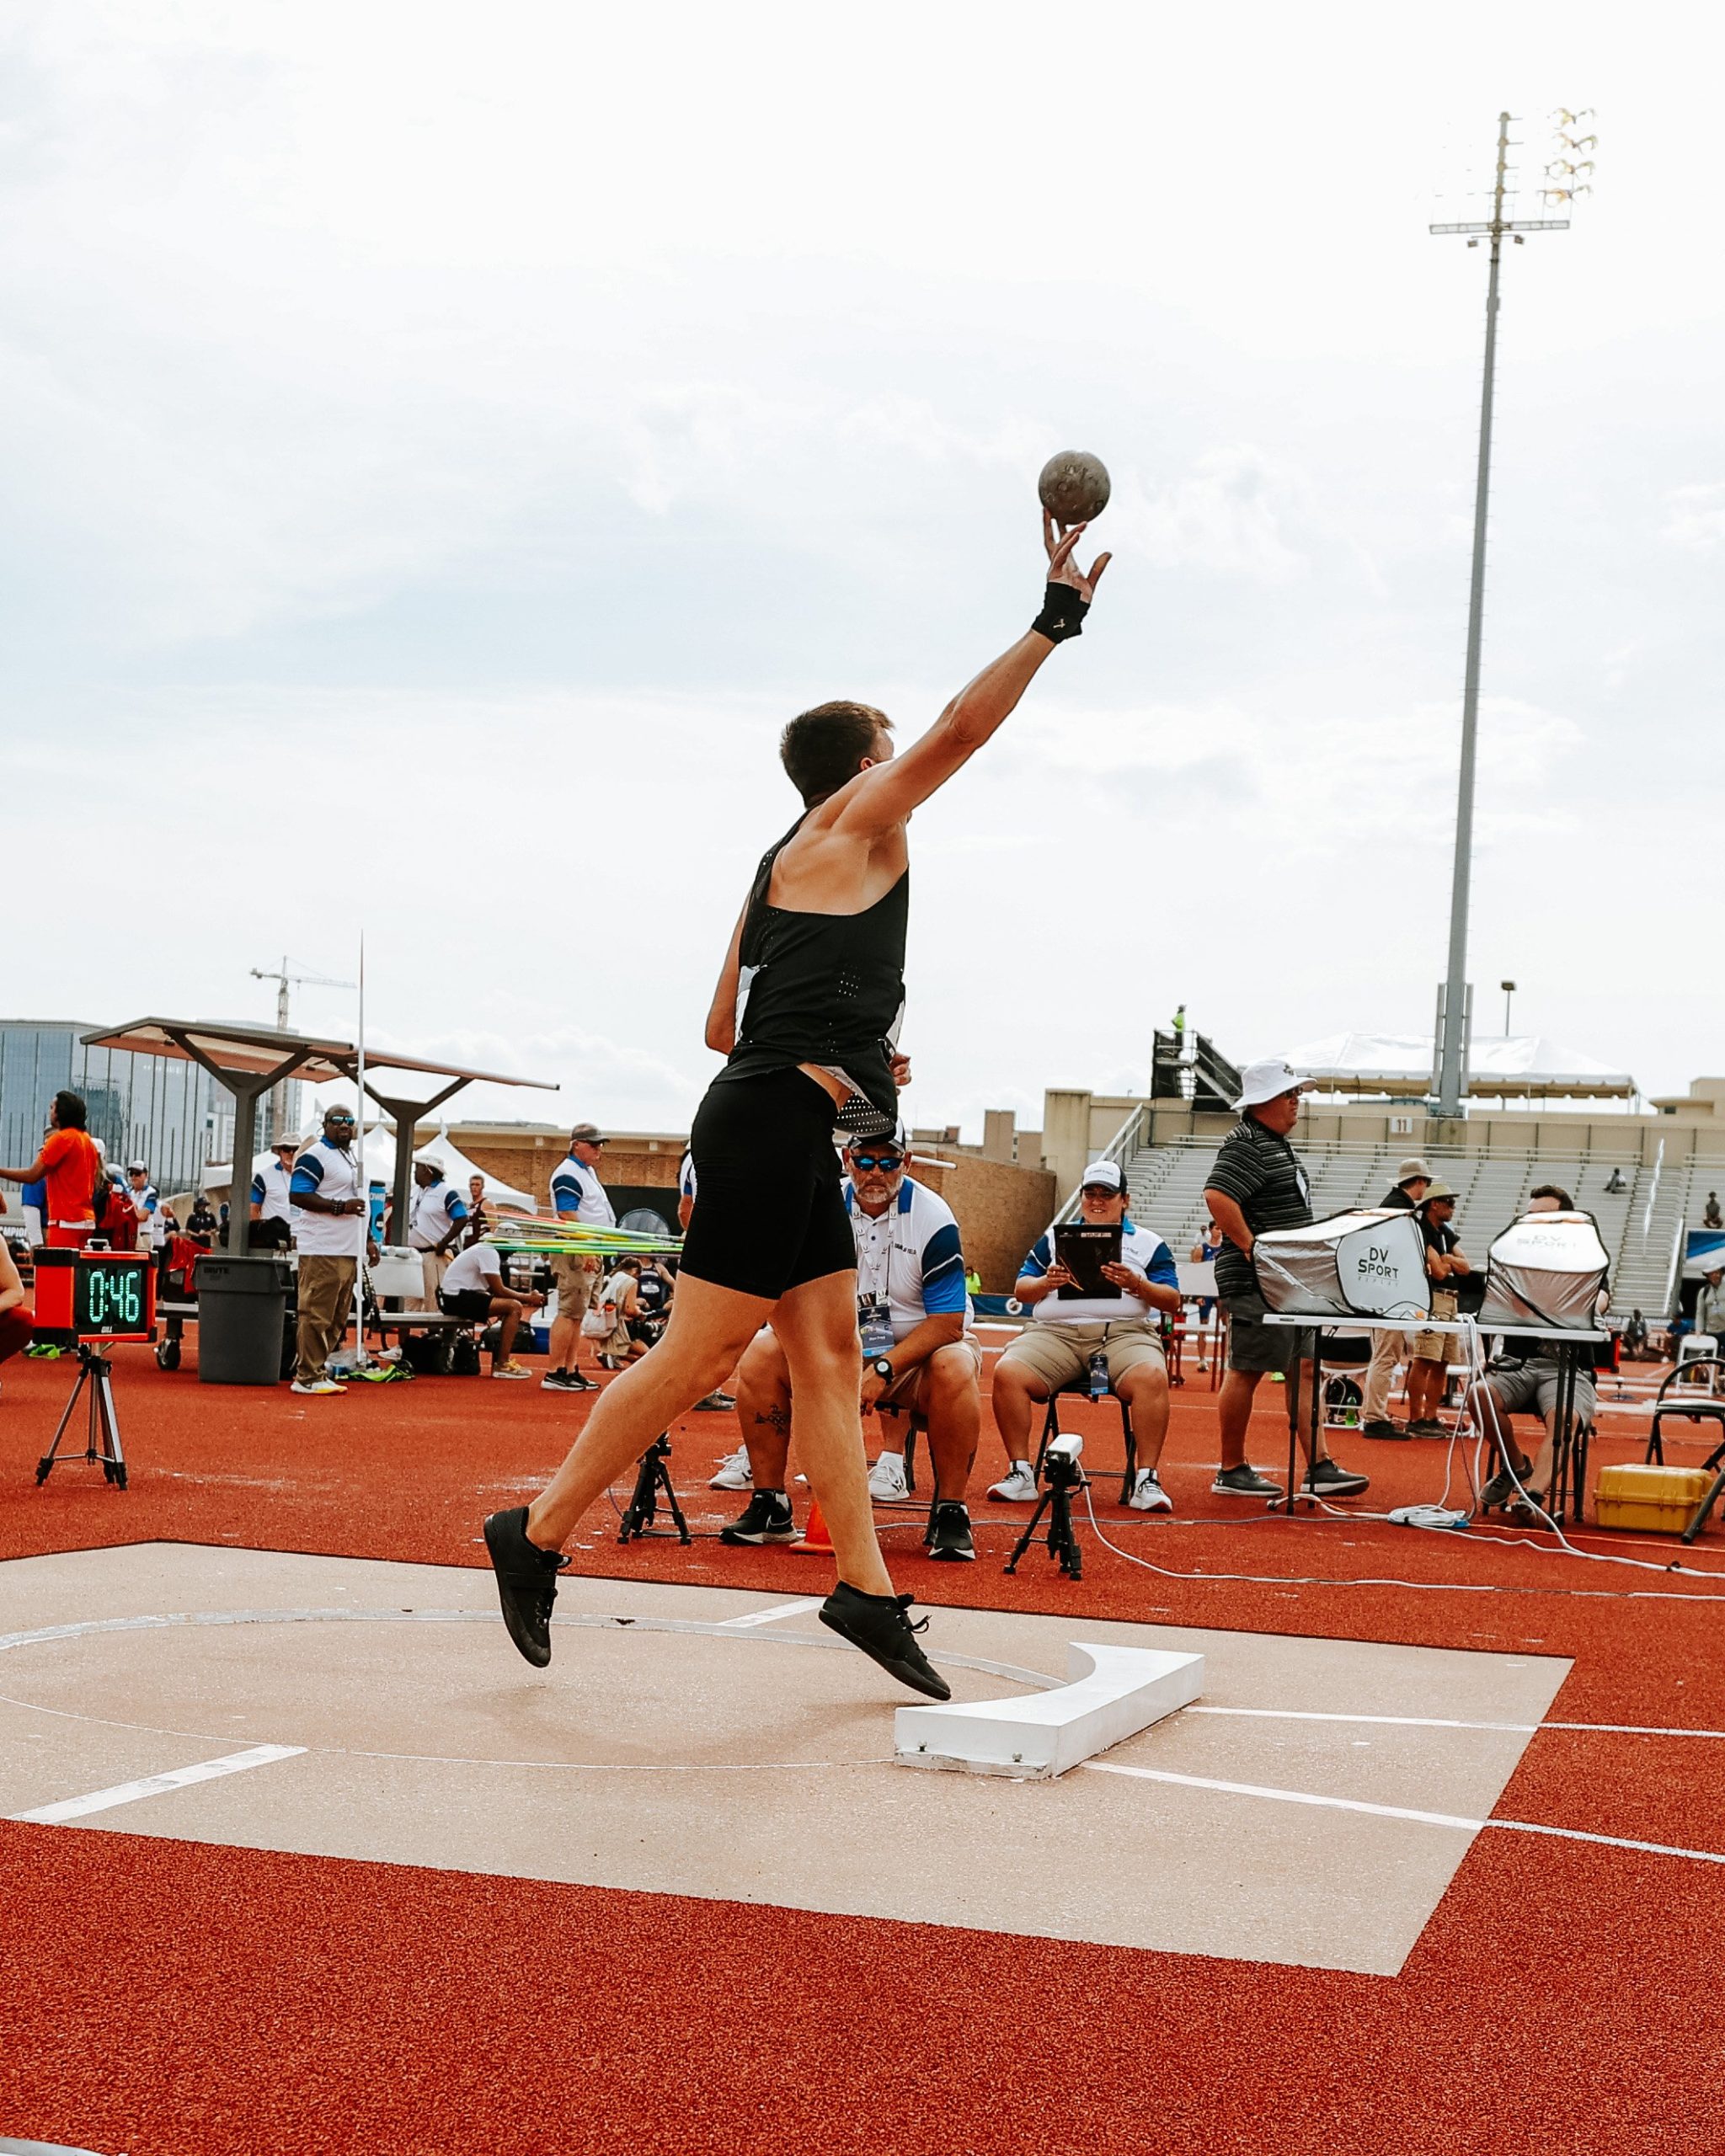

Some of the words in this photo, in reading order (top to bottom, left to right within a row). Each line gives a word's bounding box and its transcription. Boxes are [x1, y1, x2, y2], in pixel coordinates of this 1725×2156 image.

[1397, 1119, 1407, 1132] 11
[1370, 1246, 1389, 1263] DV
[1358, 1258, 1399, 1279] SPORT
[89, 1271, 139, 1323] 0:46
